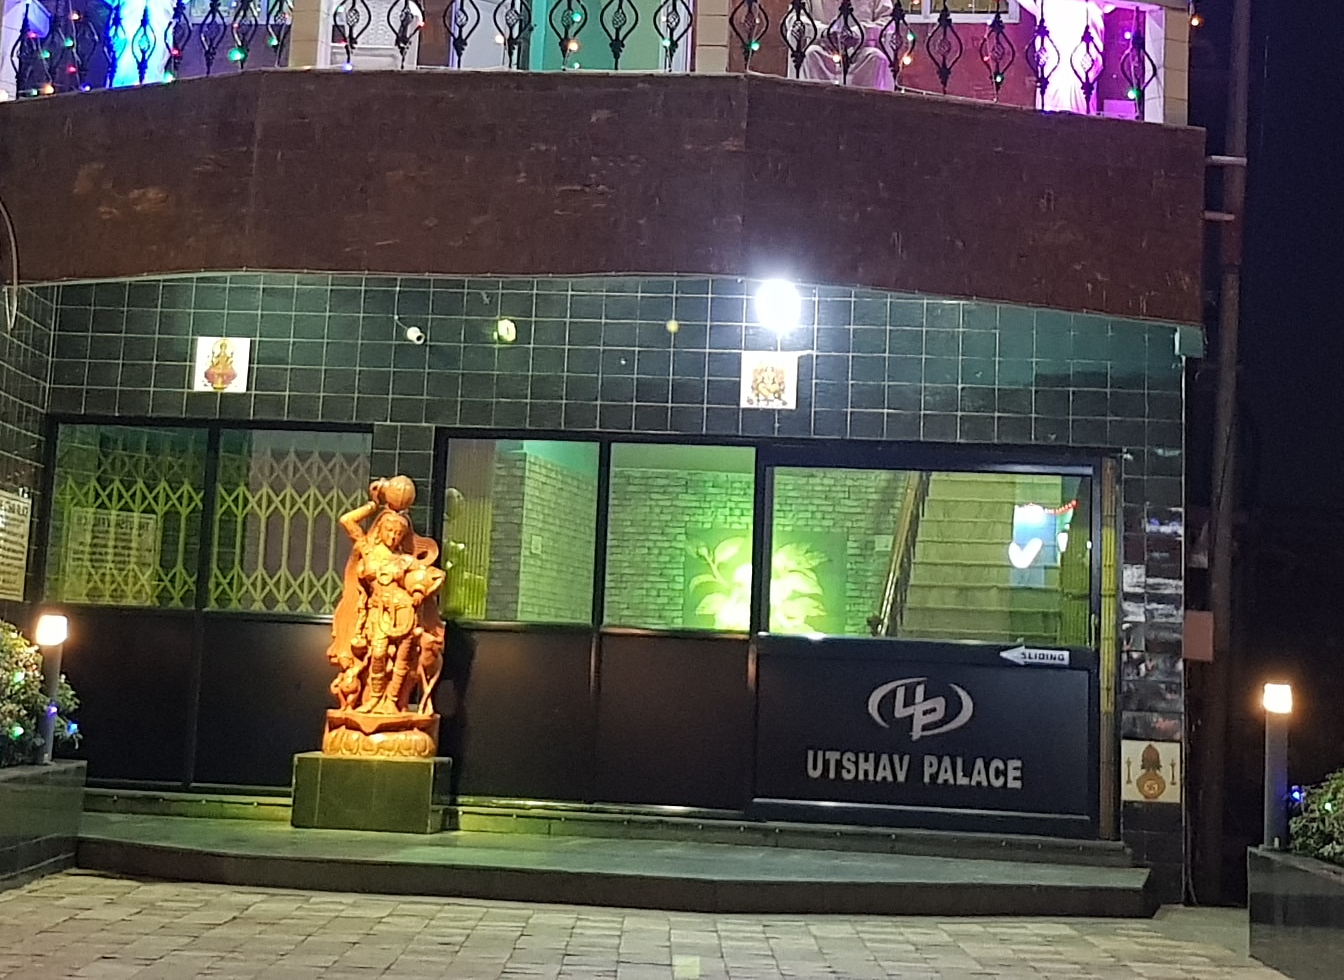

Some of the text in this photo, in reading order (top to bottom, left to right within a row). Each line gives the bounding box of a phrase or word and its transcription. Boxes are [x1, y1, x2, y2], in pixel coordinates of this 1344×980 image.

[1020, 651, 1065, 662] SLIDING
[807, 749, 1023, 789] UTSHAV PALACE
